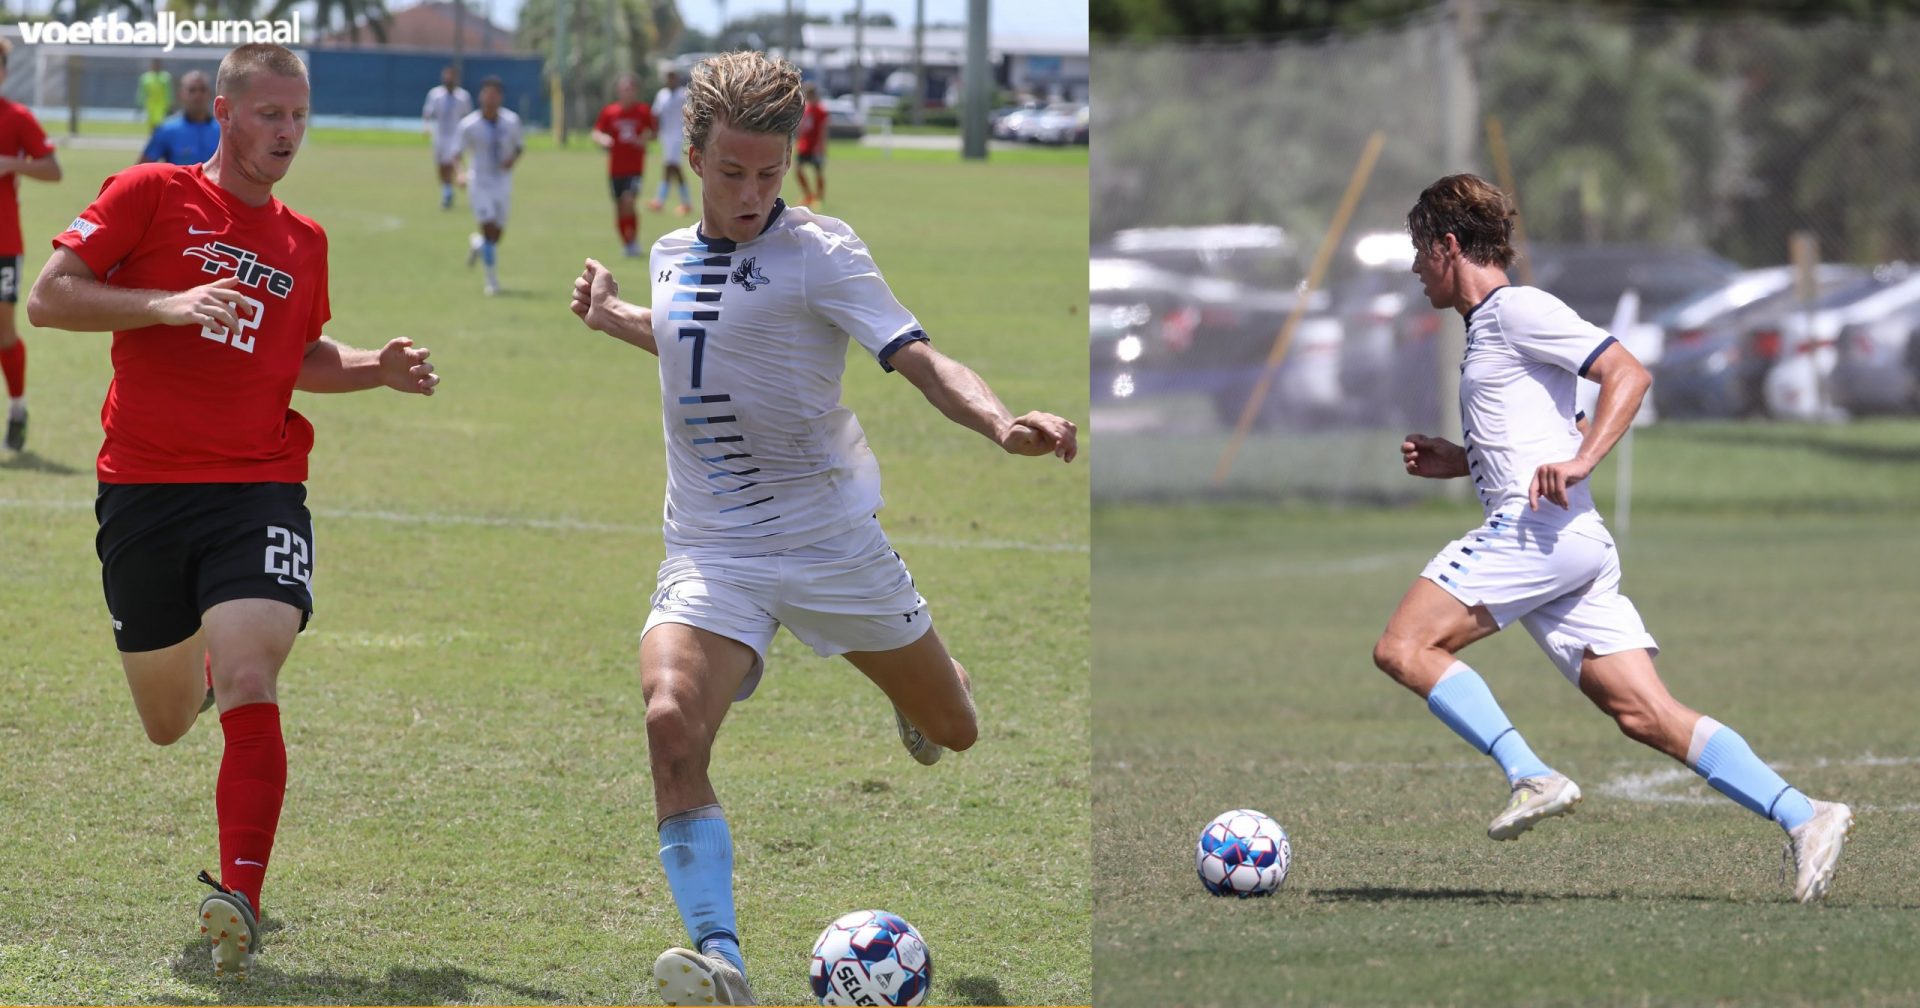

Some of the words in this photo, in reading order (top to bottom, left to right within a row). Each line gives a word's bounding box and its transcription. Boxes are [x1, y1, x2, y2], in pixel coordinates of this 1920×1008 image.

[678, 327, 706, 389] 7
[264, 525, 310, 585] 22
[837, 966, 880, 1006] SELE
